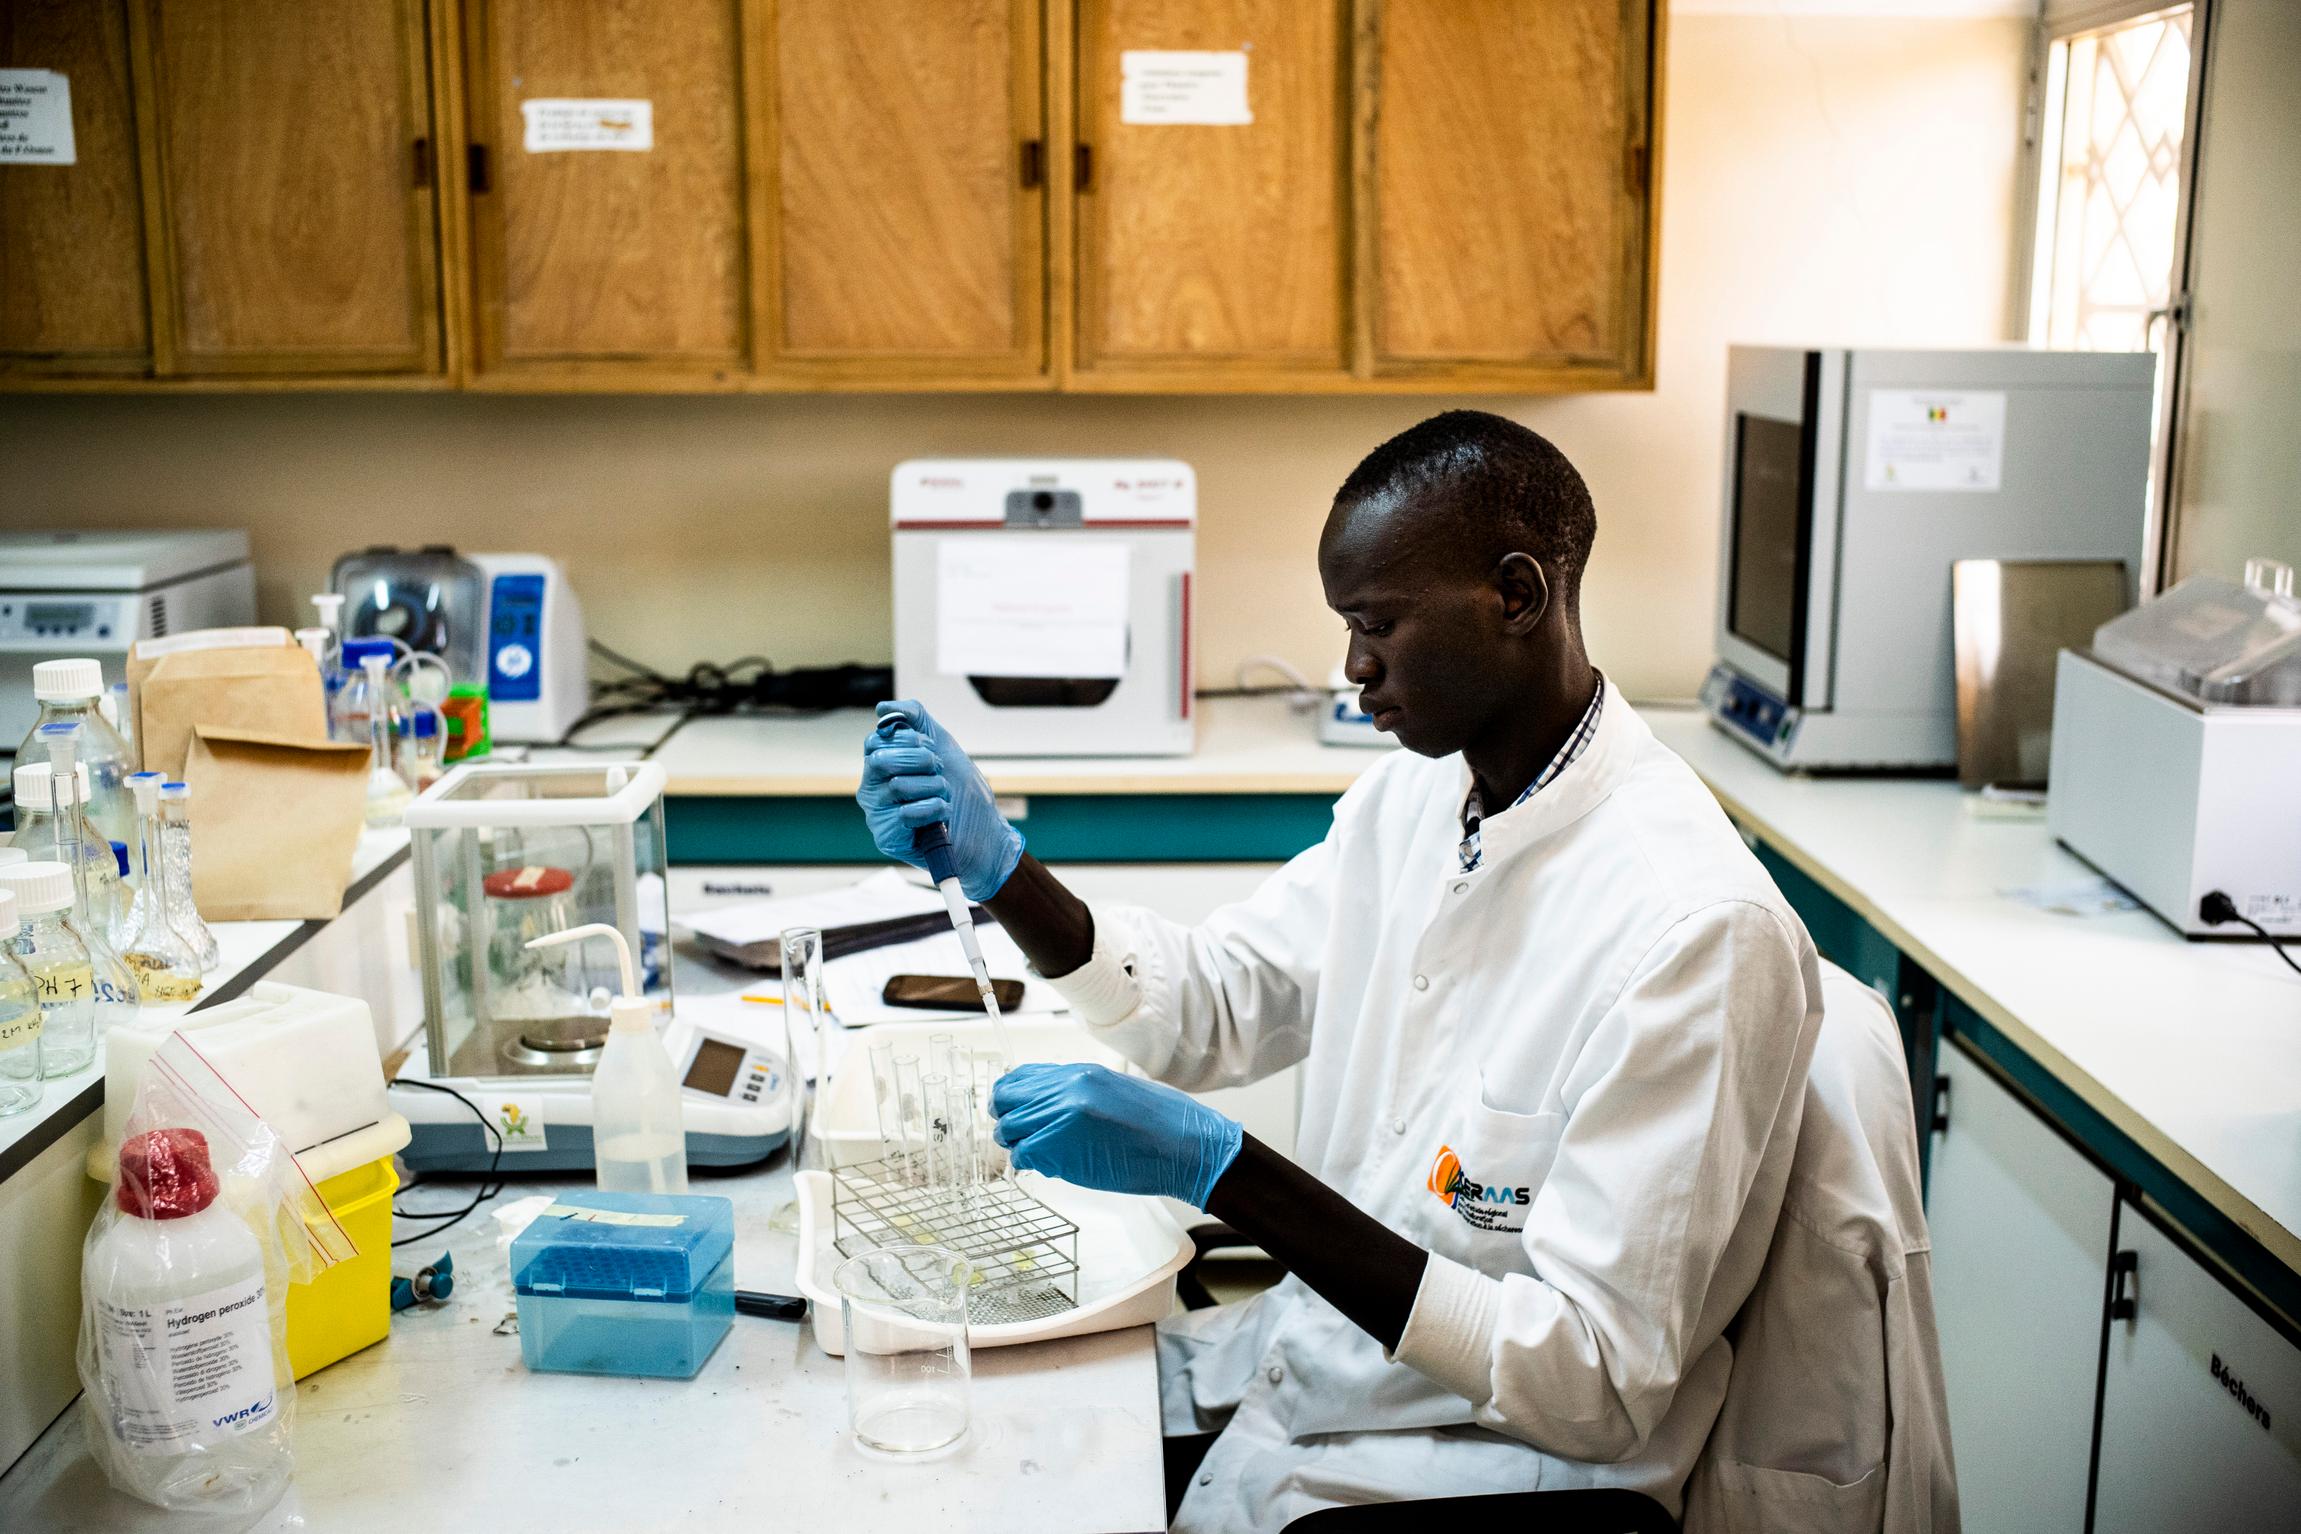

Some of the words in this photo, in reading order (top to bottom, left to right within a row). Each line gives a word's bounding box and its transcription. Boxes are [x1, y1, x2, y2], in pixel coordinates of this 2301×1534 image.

[64, 978, 82, 997] 7
[167, 1309, 217, 1329] Hydrogen
[219, 1294, 256, 1317] peroxide
[2211, 1352, 2271, 1431] Béchers
[213, 1409, 249, 1427] VWR
